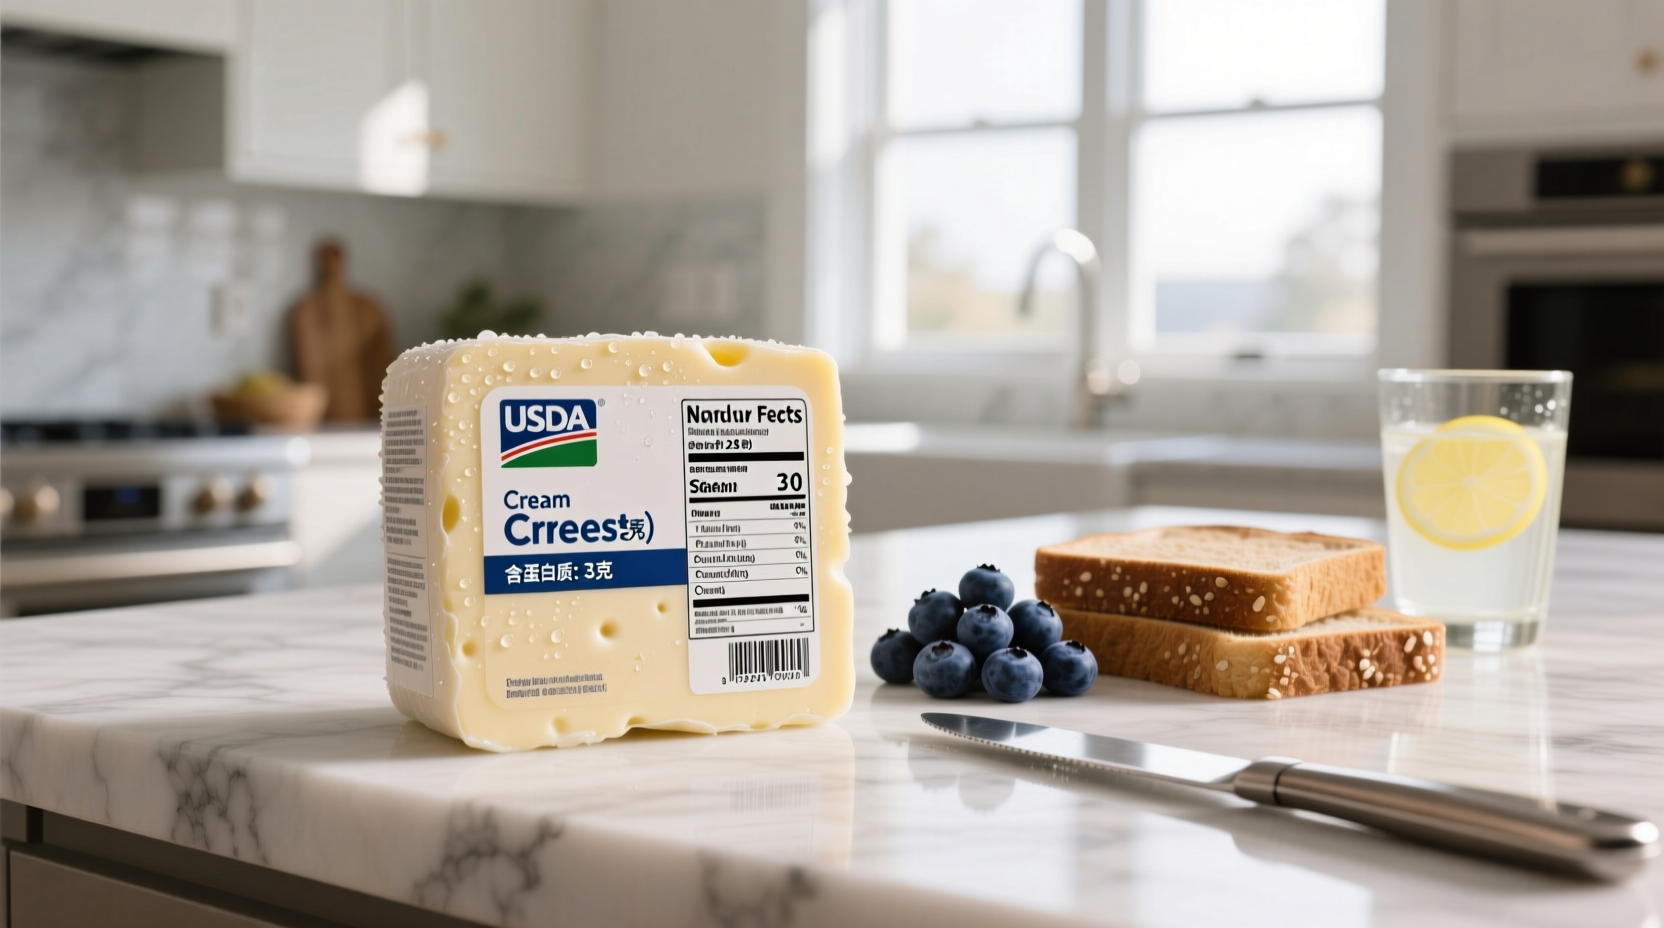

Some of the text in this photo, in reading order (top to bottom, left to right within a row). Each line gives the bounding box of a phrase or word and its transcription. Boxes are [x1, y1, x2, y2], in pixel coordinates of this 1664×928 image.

[504, 404, 590, 433] USDA
[757, 405, 803, 423] Fects
[777, 472, 802, 491] 30
[504, 490, 571, 509] Cream
